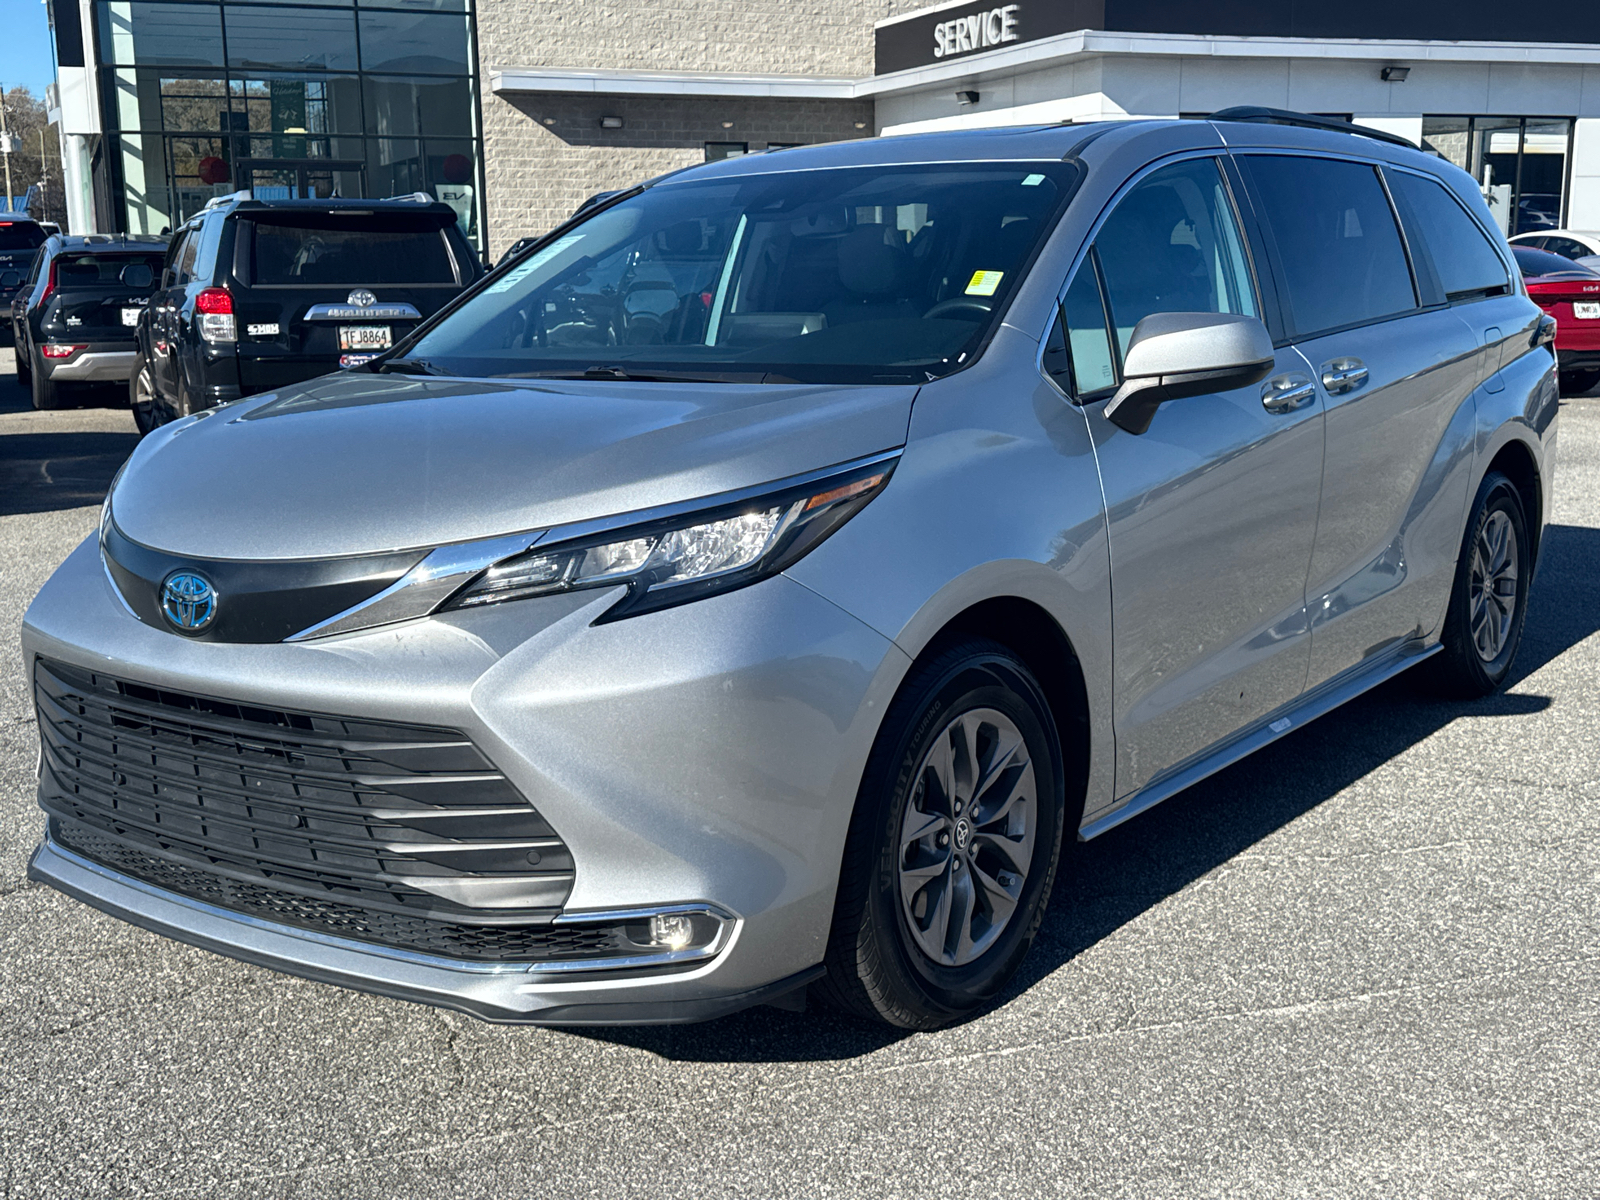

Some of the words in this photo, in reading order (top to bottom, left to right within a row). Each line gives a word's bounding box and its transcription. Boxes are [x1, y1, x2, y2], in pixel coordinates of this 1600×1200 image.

[933, 4, 1020, 58] SERVICE
[443, 192, 466, 200] EV
[343, 330, 387, 344] TFJ8864
[880, 750, 914, 893] VELOCITY
[909, 700, 942, 751] TOURING
